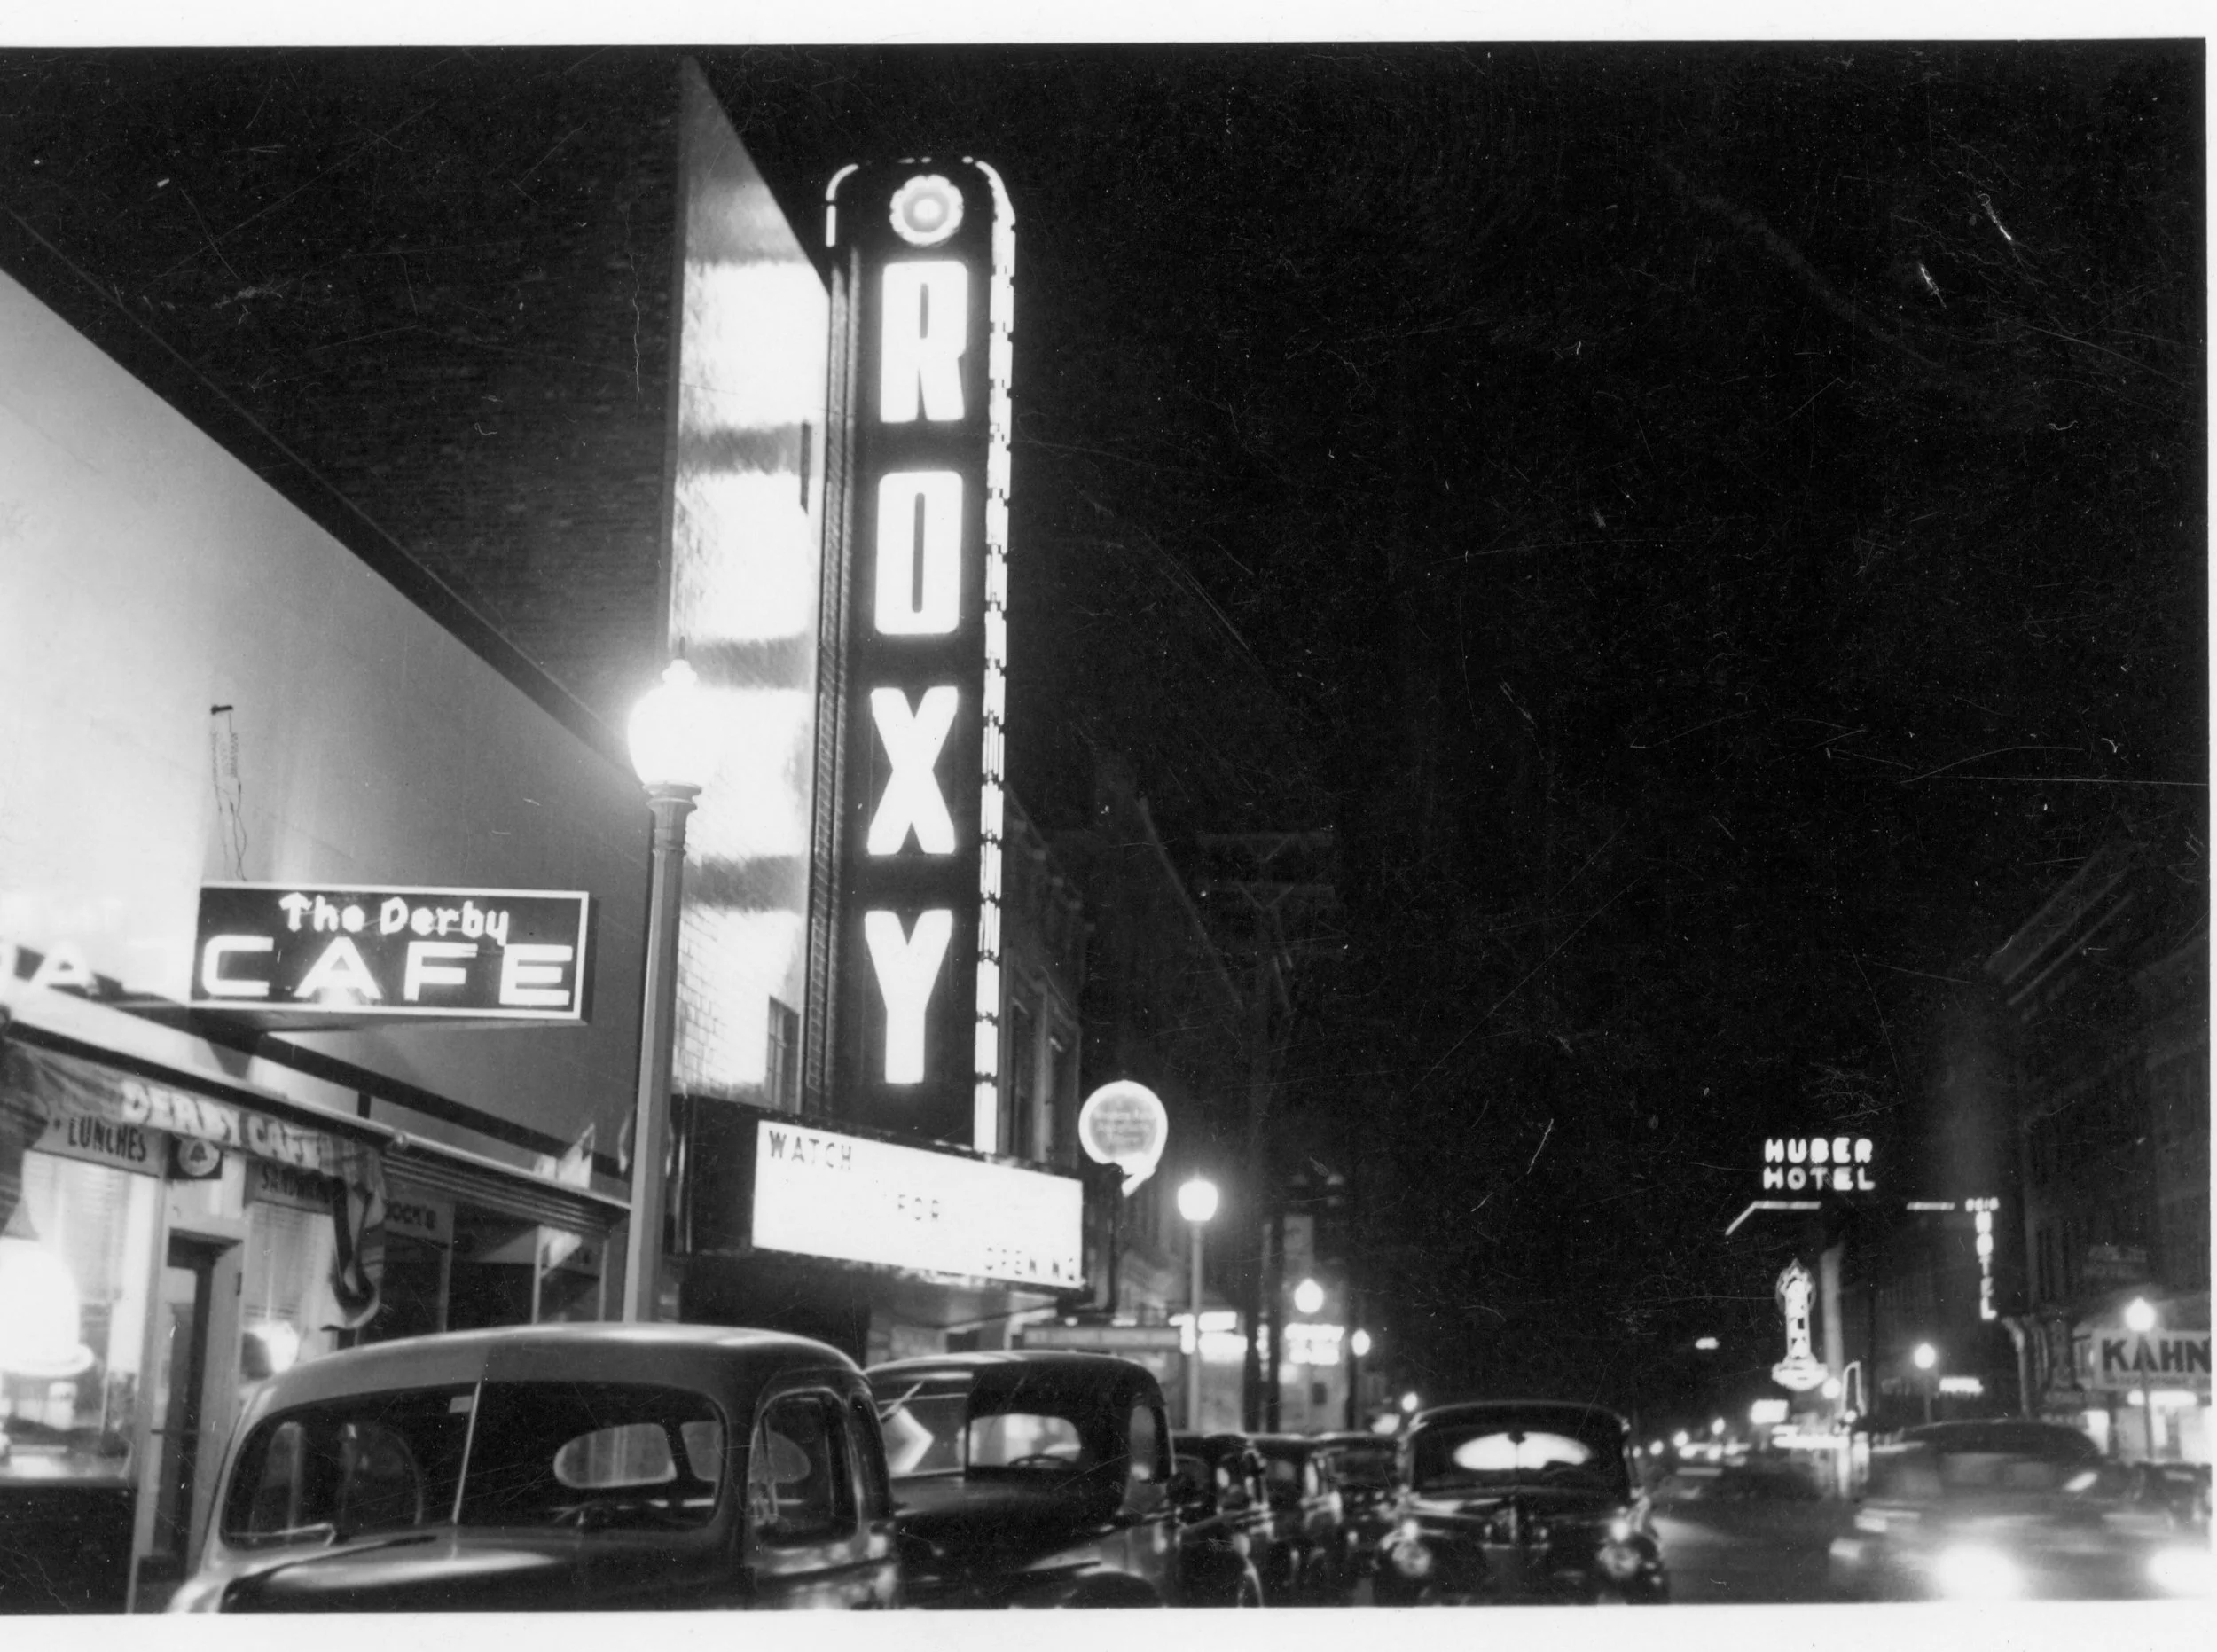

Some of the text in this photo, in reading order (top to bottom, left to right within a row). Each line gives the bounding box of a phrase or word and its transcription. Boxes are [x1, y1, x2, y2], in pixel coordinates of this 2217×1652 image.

[865, 259, 968, 1084] ROXY
[279, 891, 509, 946] The Derby
[202, 935, 573, 1006] CAFE
[67, 1116, 148, 1163] LUNCHES
[769, 1130, 852, 1170] WATCH
[1764, 1137, 1873, 1164] HUBER
[1763, 1166, 1876, 1191] HOTEL
[2102, 1336, 2211, 1374] KAHN
